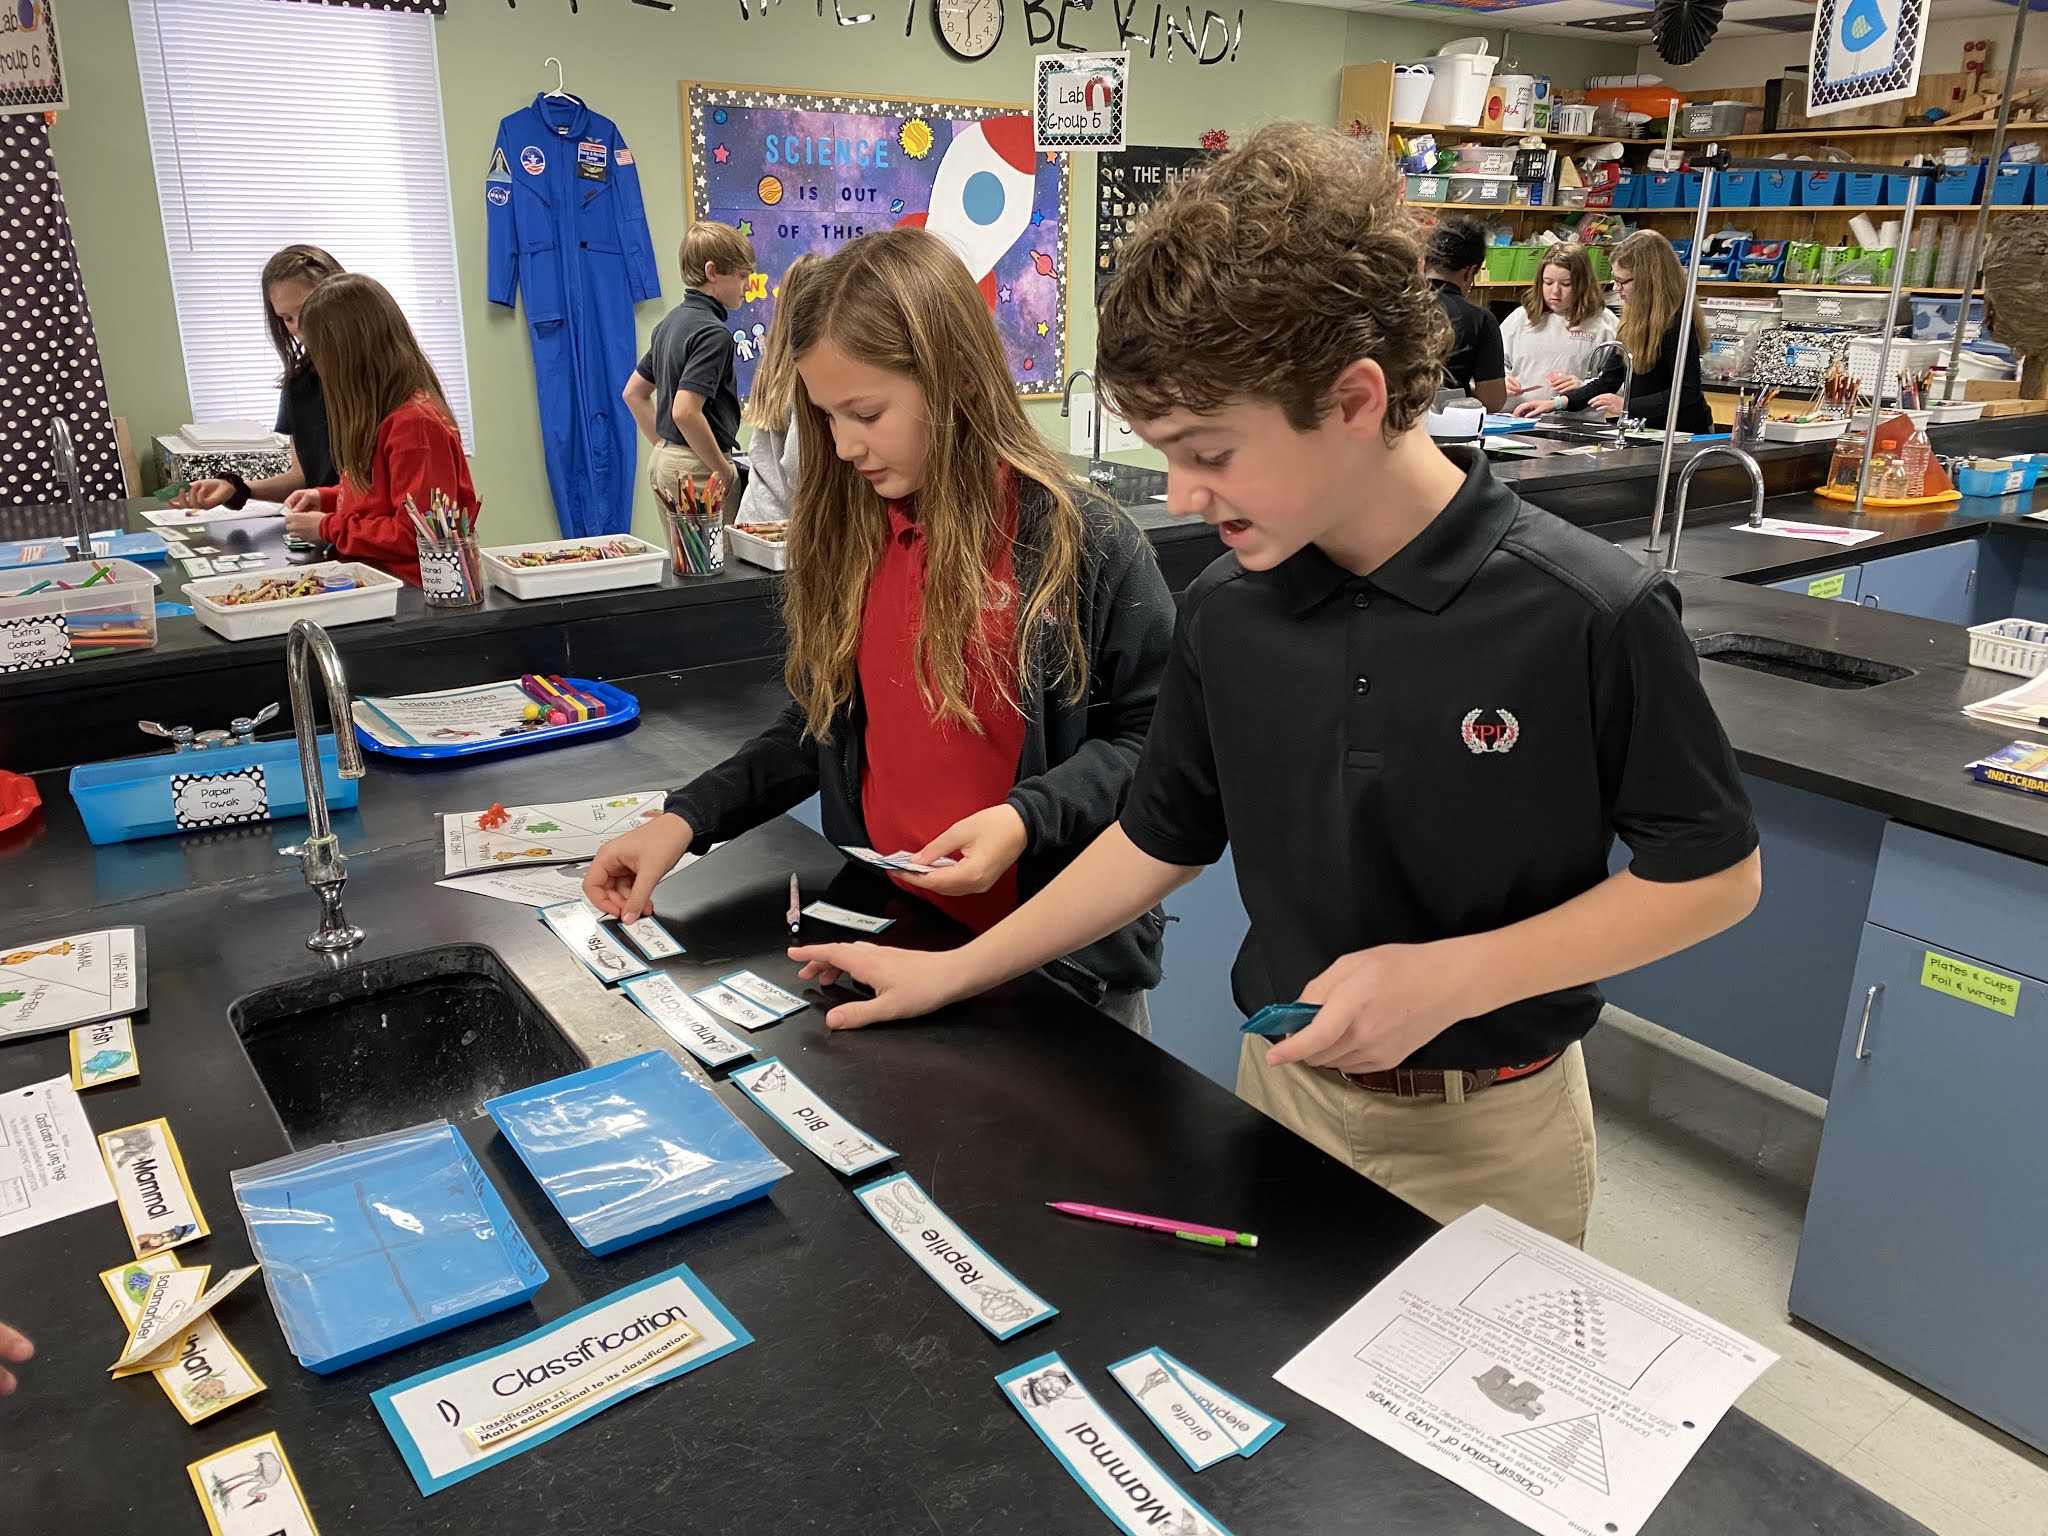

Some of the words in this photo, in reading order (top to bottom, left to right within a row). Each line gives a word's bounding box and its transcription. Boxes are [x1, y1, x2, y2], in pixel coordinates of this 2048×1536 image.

[0, 6, 18, 34] ab
[1114, 0, 1243, 64] KIND!
[0, 50, 28, 79] roup
[32, 45, 40, 67] 6
[1059, 86, 1084, 104] Lab
[1047, 112, 1087, 134] Group
[1092, 112, 1101, 129] 5
[765, 134, 888, 168] SCIENCE
[1133, 166, 1160, 184] THE
[800, 186, 818, 200] IS
[841, 187, 877, 202] OUT
[778, 225, 800, 239] OF
[822, 225, 864, 239] THIS
[7, 637, 46, 650] Colored
[12, 628, 40, 638] Extra
[13, 649, 47, 660] Pencils
[200, 787, 235, 798] Paper
[202, 798, 240, 809] Towels
[112, 952, 128, 972] WHAT
[1931, 958, 1968, 976] Plates
[1931, 973, 1952, 986] Foil
[92, 1025, 114, 1047] Fish
[793, 1107, 829, 1132] Bird
[132, 1158, 174, 1221] Mammal
[921, 1229, 983, 1285] Reptile
[136, 1274, 170, 1340] salamander
[1497, 1314, 1532, 1335] System
[492, 1305, 688, 1397] Classification
[1533, 1333, 1595, 1367] Classification
[479, 1420, 518, 1442] Match
[519, 1408, 549, 1425] each
[550, 1387, 591, 1411] animal
[591, 1379, 605, 1390] to
[604, 1371, 619, 1385] its
[621, 1331, 692, 1375] classification.
[1365, 1390, 1401, 1416] Things
[474, 1397, 552, 1435] Classification
[1171, 1403, 1212, 1442] giraffe
[1404, 1411, 1439, 1437] Living
[1426, 1440, 1461, 1461] Number
[1439, 1435, 1459, 1445] of
[1065, 1422, 1172, 1525] Mammal
[1455, 1444, 1543, 1496] Classification
